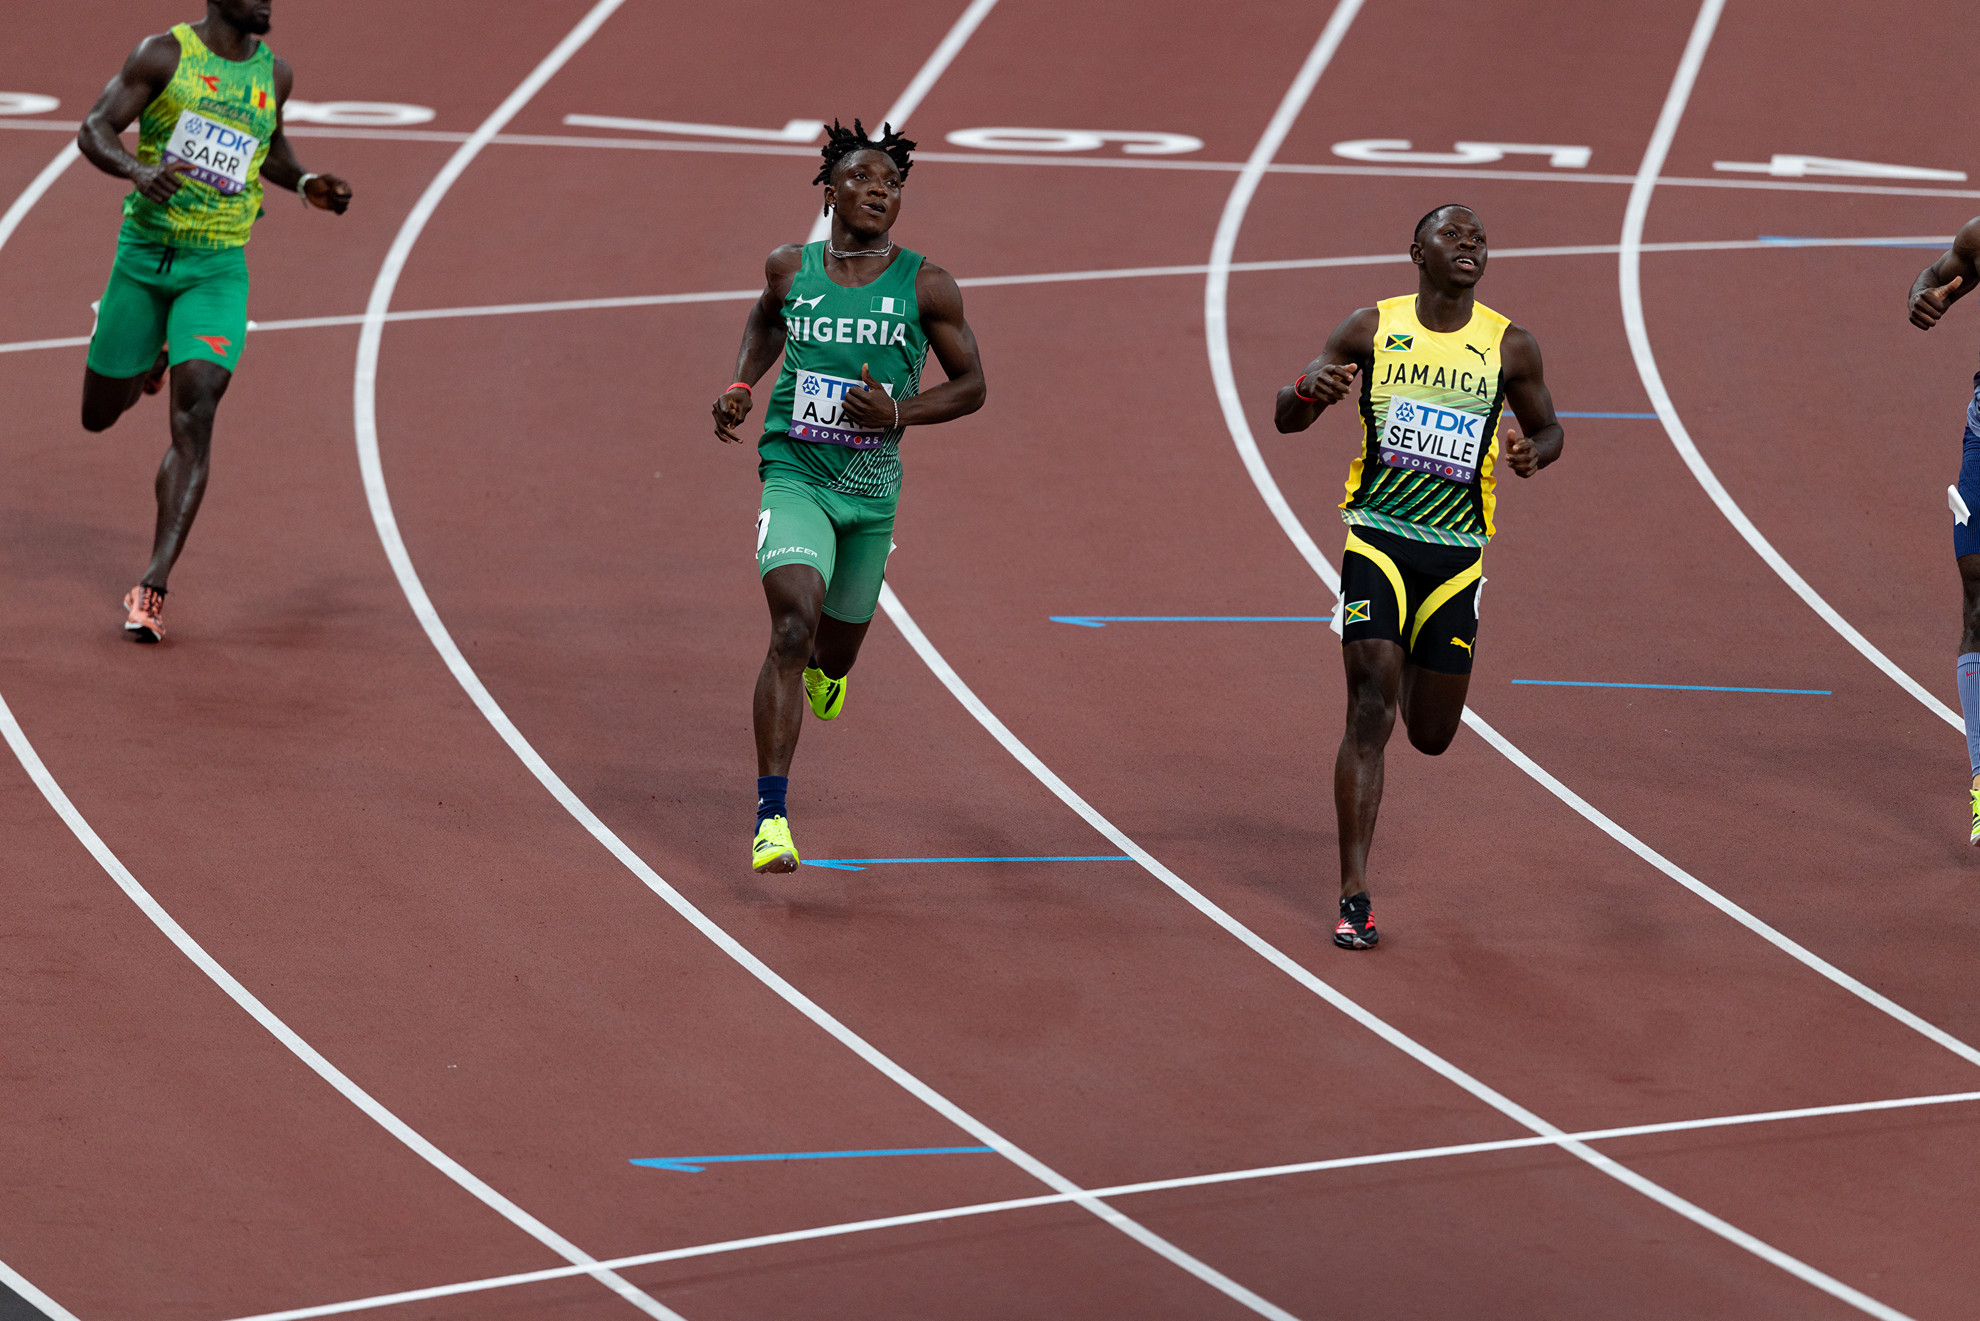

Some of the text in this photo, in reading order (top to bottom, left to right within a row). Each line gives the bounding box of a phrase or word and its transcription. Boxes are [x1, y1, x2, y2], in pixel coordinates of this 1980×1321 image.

[204, 121, 252, 155] TDK
[1331, 139, 1592, 168] 5
[181, 140, 240, 175] SARR
[786, 316, 907, 347] NIGERIA
[1380, 363, 1488, 399] JAMAICA
[802, 401, 864, 429] AJA
[1416, 405, 1478, 438] TDK
[1387, 425, 1475, 464] SEVILLE
